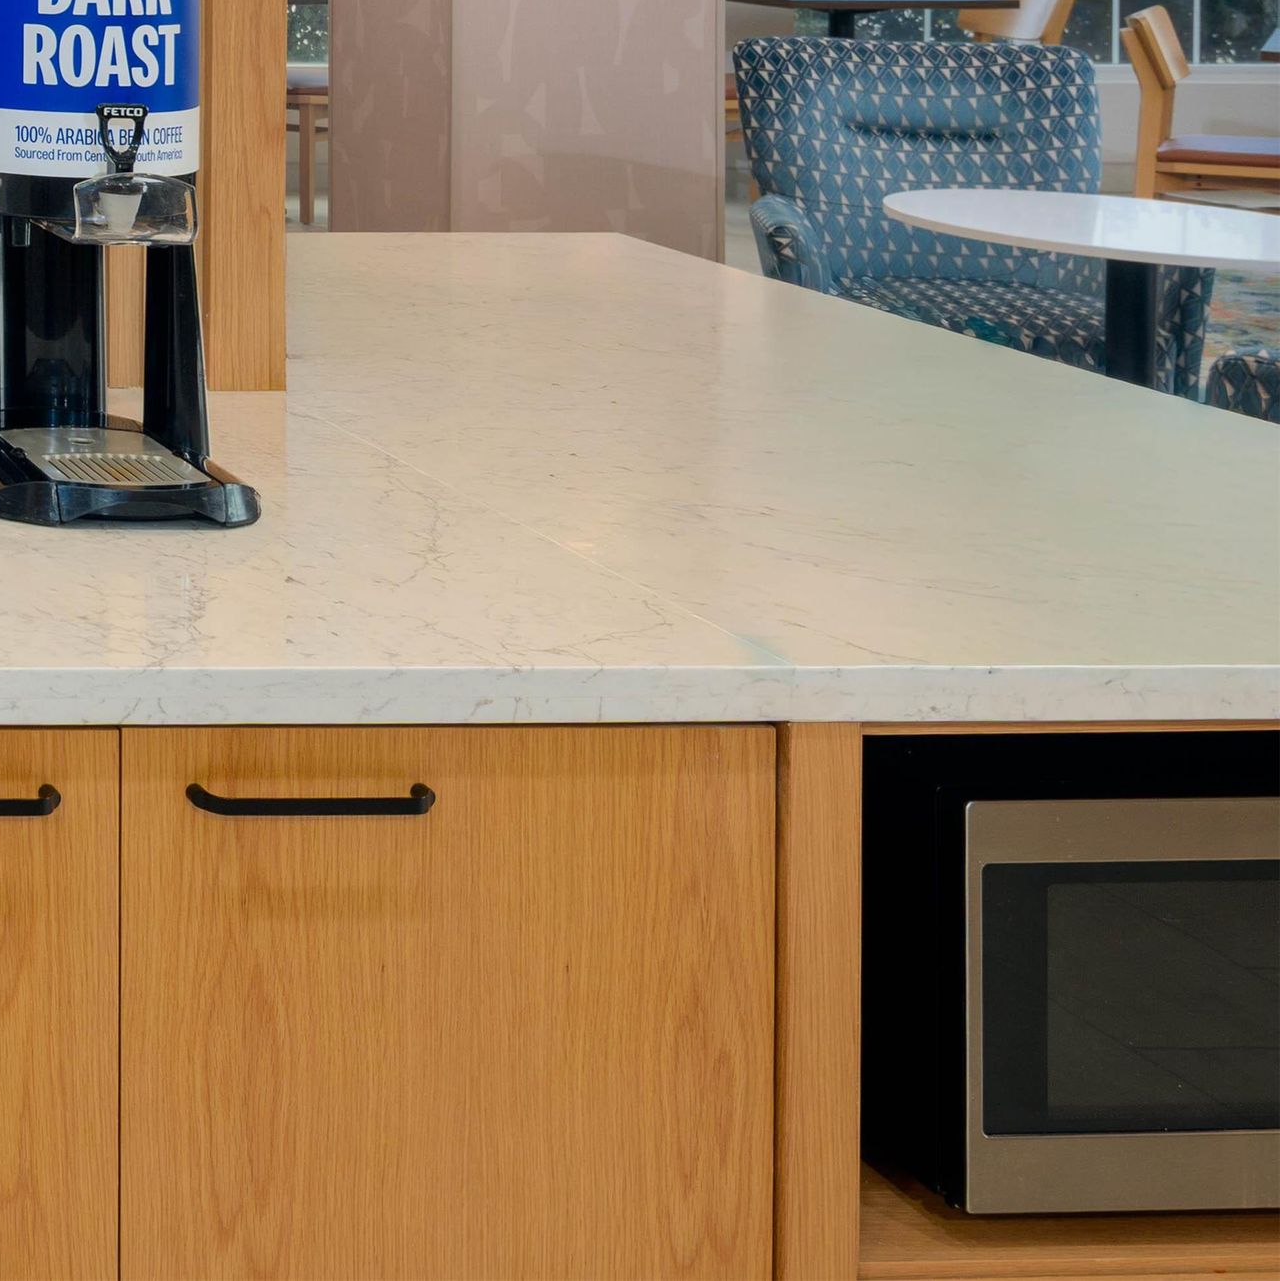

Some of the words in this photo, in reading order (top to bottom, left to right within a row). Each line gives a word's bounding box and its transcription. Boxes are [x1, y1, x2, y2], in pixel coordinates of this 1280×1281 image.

[23, 24, 180, 87] ROAST
[103, 107, 143, 117] FETCO
[15, 125, 52, 144] 100%
[153, 126, 183, 144] COFFEE
[14, 147, 55, 160] Sourced
[57, 149, 83, 161] From
[136, 150, 156, 162] outh
[157, 149, 183, 160] America
